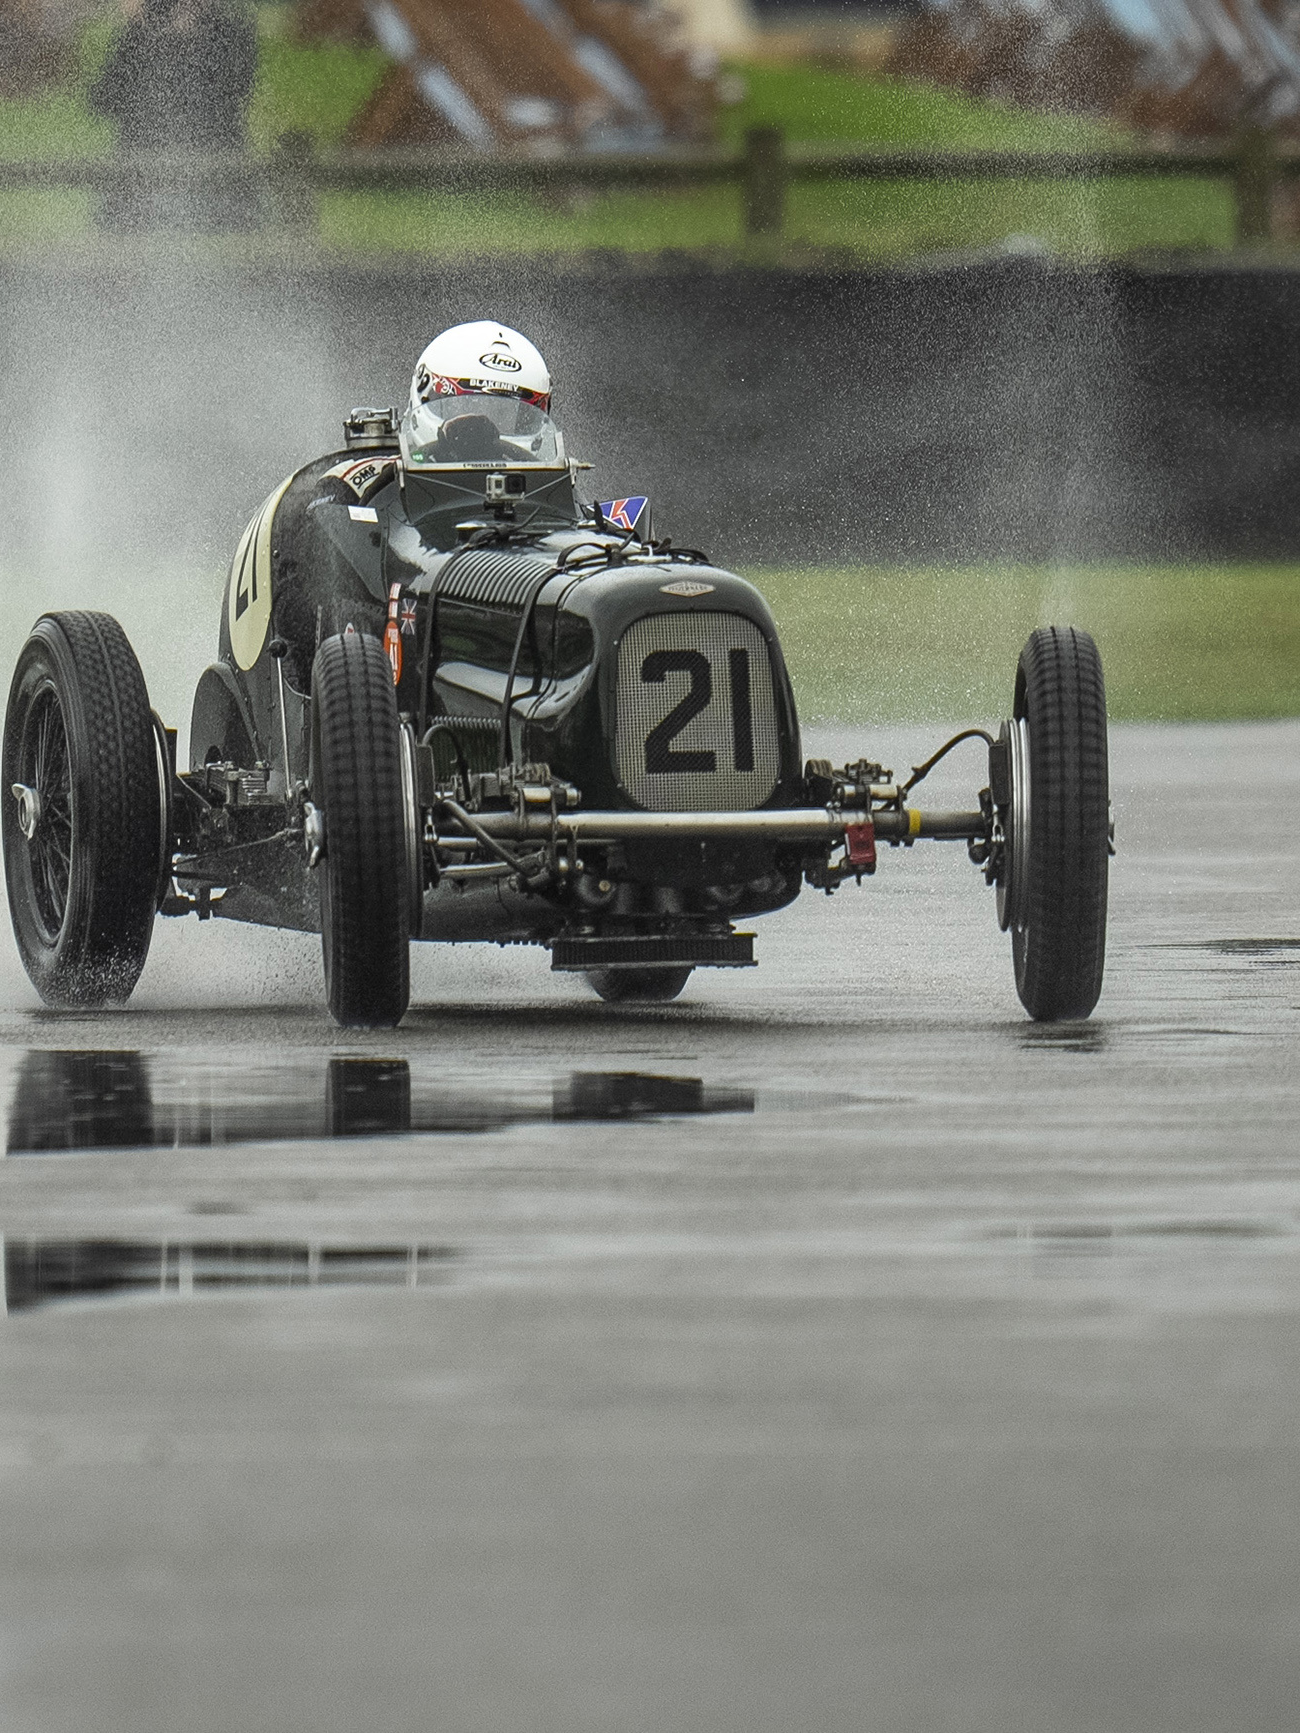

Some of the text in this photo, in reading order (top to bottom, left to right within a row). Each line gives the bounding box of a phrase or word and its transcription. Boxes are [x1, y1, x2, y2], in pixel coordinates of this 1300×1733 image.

[484, 354, 517, 369] Arai
[469, 379, 519, 392] BLAKENEY
[352, 466, 377, 486] OMP
[235, 496, 272, 623] 21
[641, 648, 755, 775] 21
